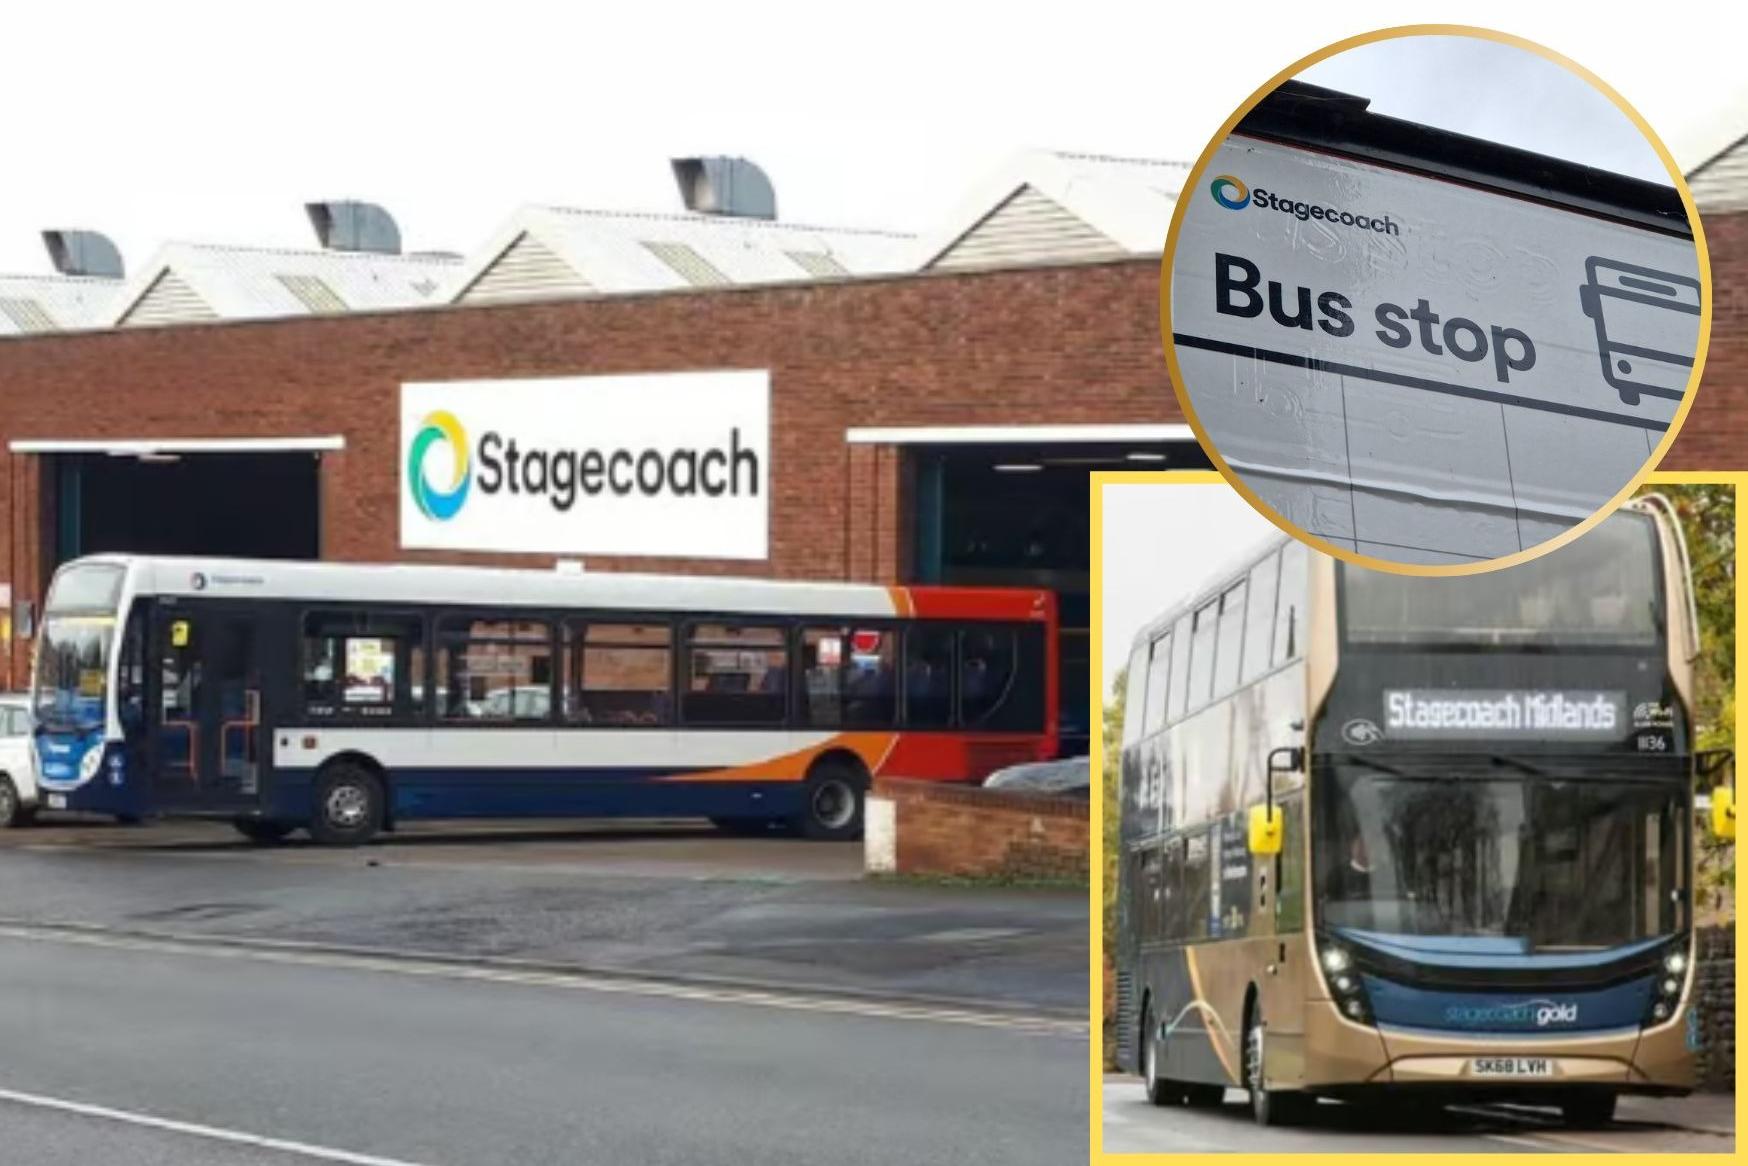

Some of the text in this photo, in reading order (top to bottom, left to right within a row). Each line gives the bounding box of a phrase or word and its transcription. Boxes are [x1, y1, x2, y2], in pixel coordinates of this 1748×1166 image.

[1252, 188, 1399, 236] Stagecoach
[1214, 252, 1356, 338] Bus
[1375, 298, 1537, 383] stop
[477, 427, 759, 512] Stagecoach
[1388, 691, 1519, 729] Stagecoach
[1524, 693, 1616, 730] Midlands
[1537, 1003, 1577, 1026] gold
